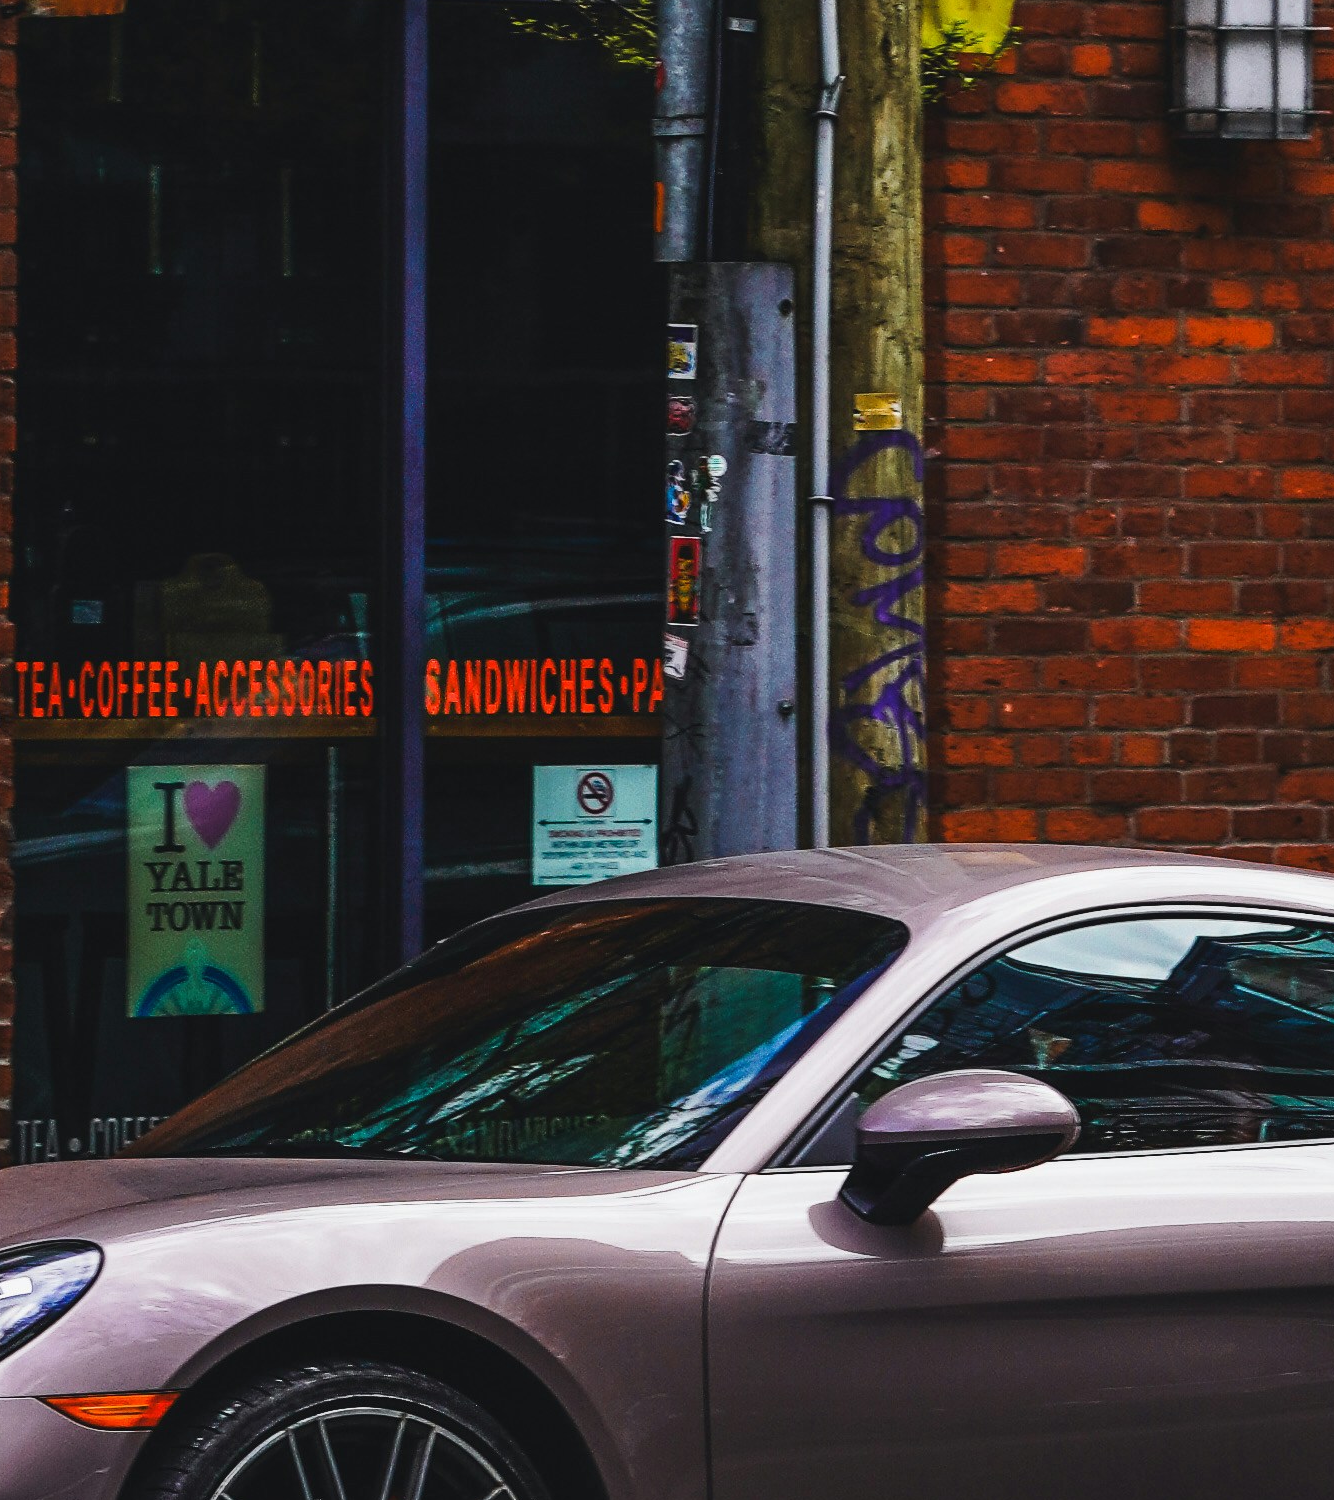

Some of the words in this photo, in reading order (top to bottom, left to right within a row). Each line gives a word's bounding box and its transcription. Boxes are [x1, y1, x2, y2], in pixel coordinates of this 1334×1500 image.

[15, 661, 64, 718] TEA
[79, 660, 180, 718] COFFEE
[193, 659, 375, 718] ACCESSORIES
[425, 657, 614, 715] SANDWICHES
[144, 861, 244, 892] YALE
[146, 901, 245, 931] TOWN
